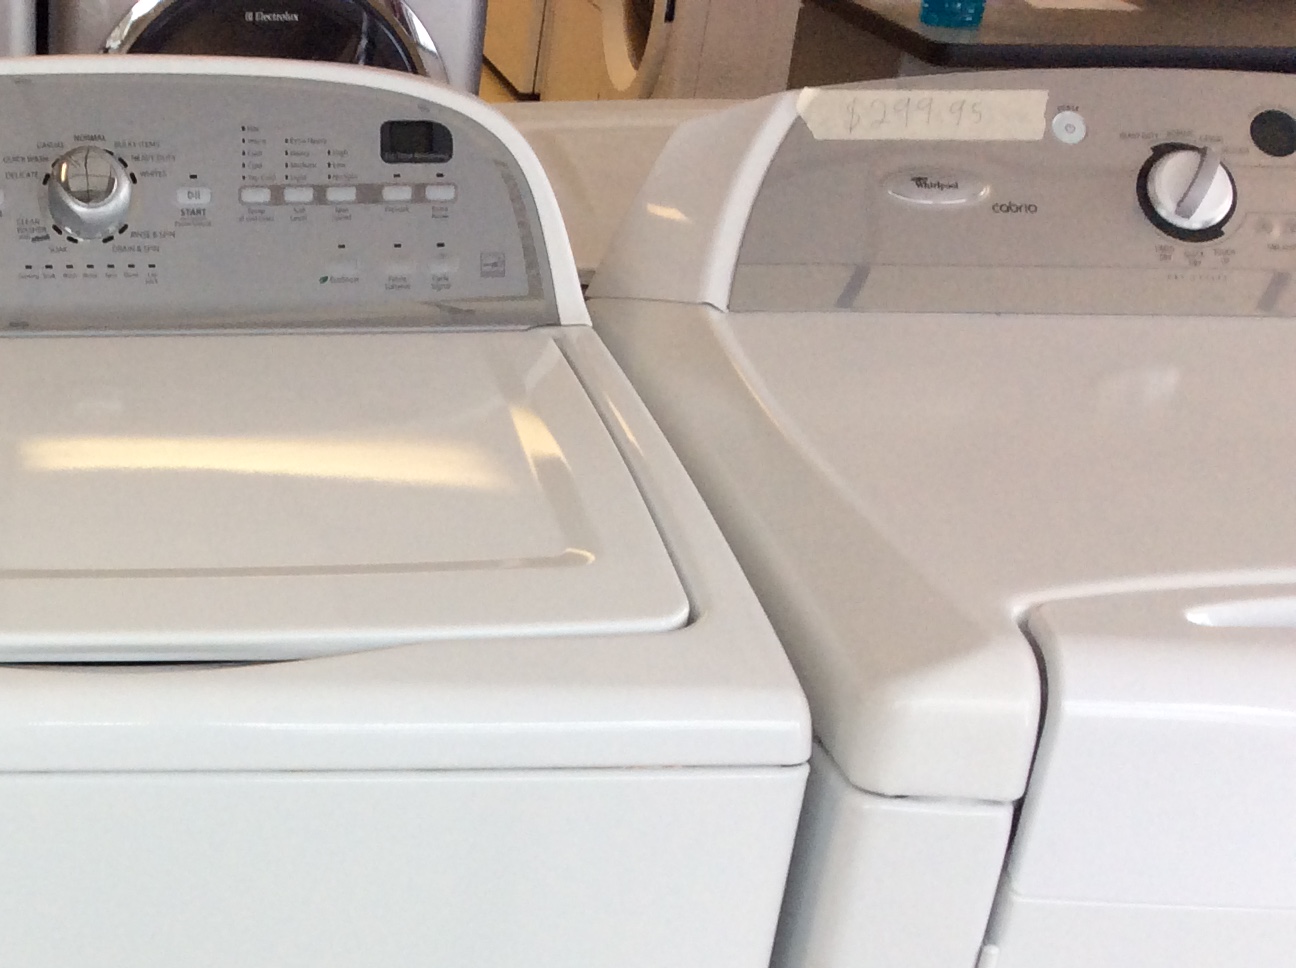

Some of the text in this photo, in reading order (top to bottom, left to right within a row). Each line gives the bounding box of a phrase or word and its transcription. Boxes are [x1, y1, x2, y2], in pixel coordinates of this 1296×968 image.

[910, 176, 959, 191] Whirlpool
[180, 207, 207, 217] START
[991, 201, 1038, 214] cabrio
